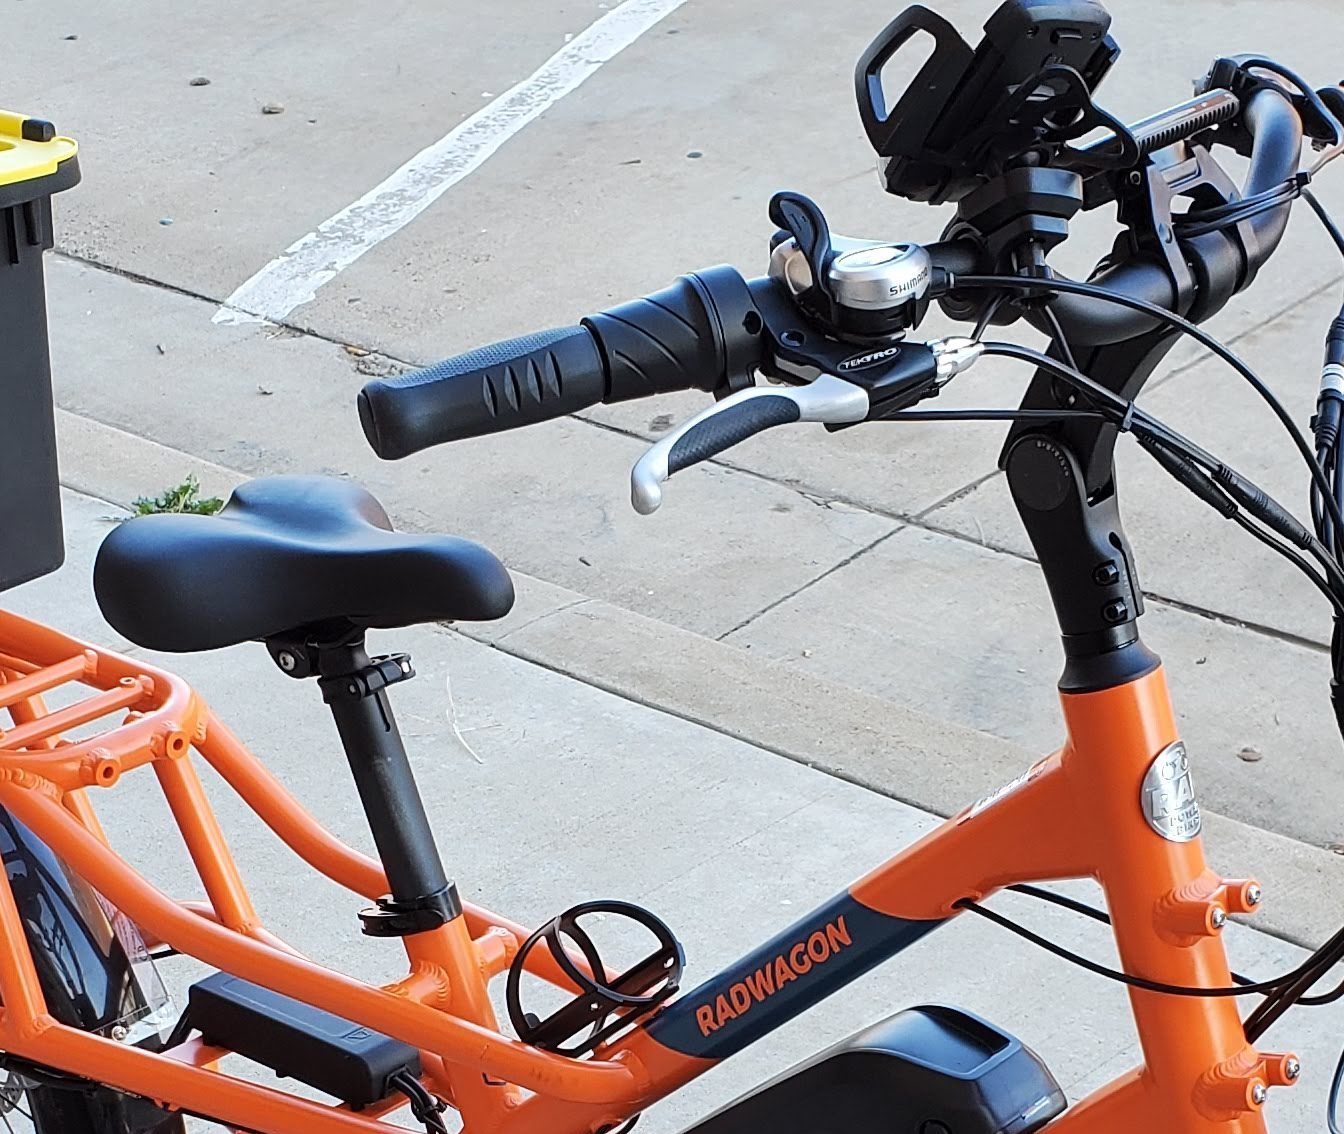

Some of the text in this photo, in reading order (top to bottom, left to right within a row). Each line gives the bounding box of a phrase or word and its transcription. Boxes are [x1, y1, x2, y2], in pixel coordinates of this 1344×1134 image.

[889, 267, 929, 297] SHIMANO
[843, 347, 898, 370] TEKTRO
[695, 914, 853, 1038] RADWAGON
